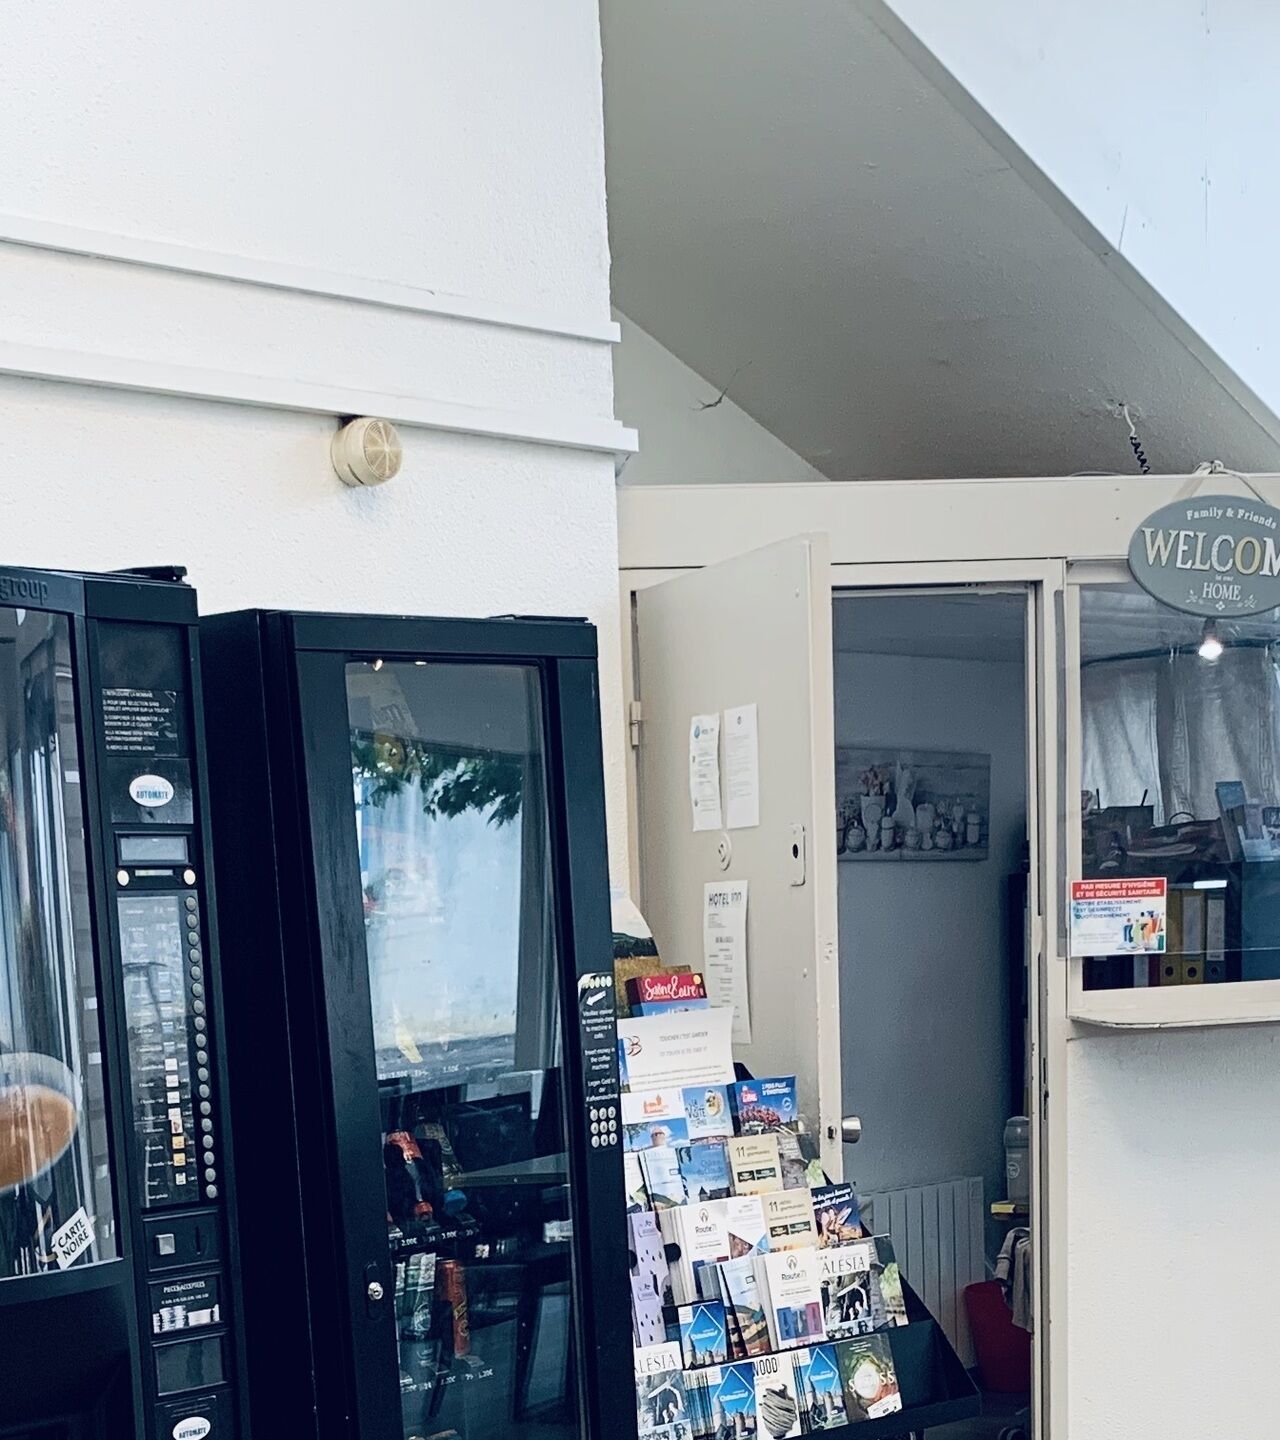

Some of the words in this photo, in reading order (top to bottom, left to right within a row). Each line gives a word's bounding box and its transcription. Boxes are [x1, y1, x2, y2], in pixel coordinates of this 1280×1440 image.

[1187, 507, 1223, 521] Family
[1226, 508, 1234, 518] &
[1237, 508, 1277, 530] Friends
[1202, 582, 1242, 601] HOME
[136, 790, 169, 800] AUTOMATE
[1095, 881, 1121, 889] MESURE
[708, 892, 730, 906] HOTEL
[1096, 889, 1127, 897] SÉCURITÉ
[1128, 888, 1161, 896] SANITAIRE
[735, 1146, 745, 1158] 11
[768, 1201, 778, 1212] 11
[58, 1218, 85, 1248] CARTE
[62, 1228, 89, 1259] NOIRE
[821, 1256, 865, 1274] ALÉSIA
